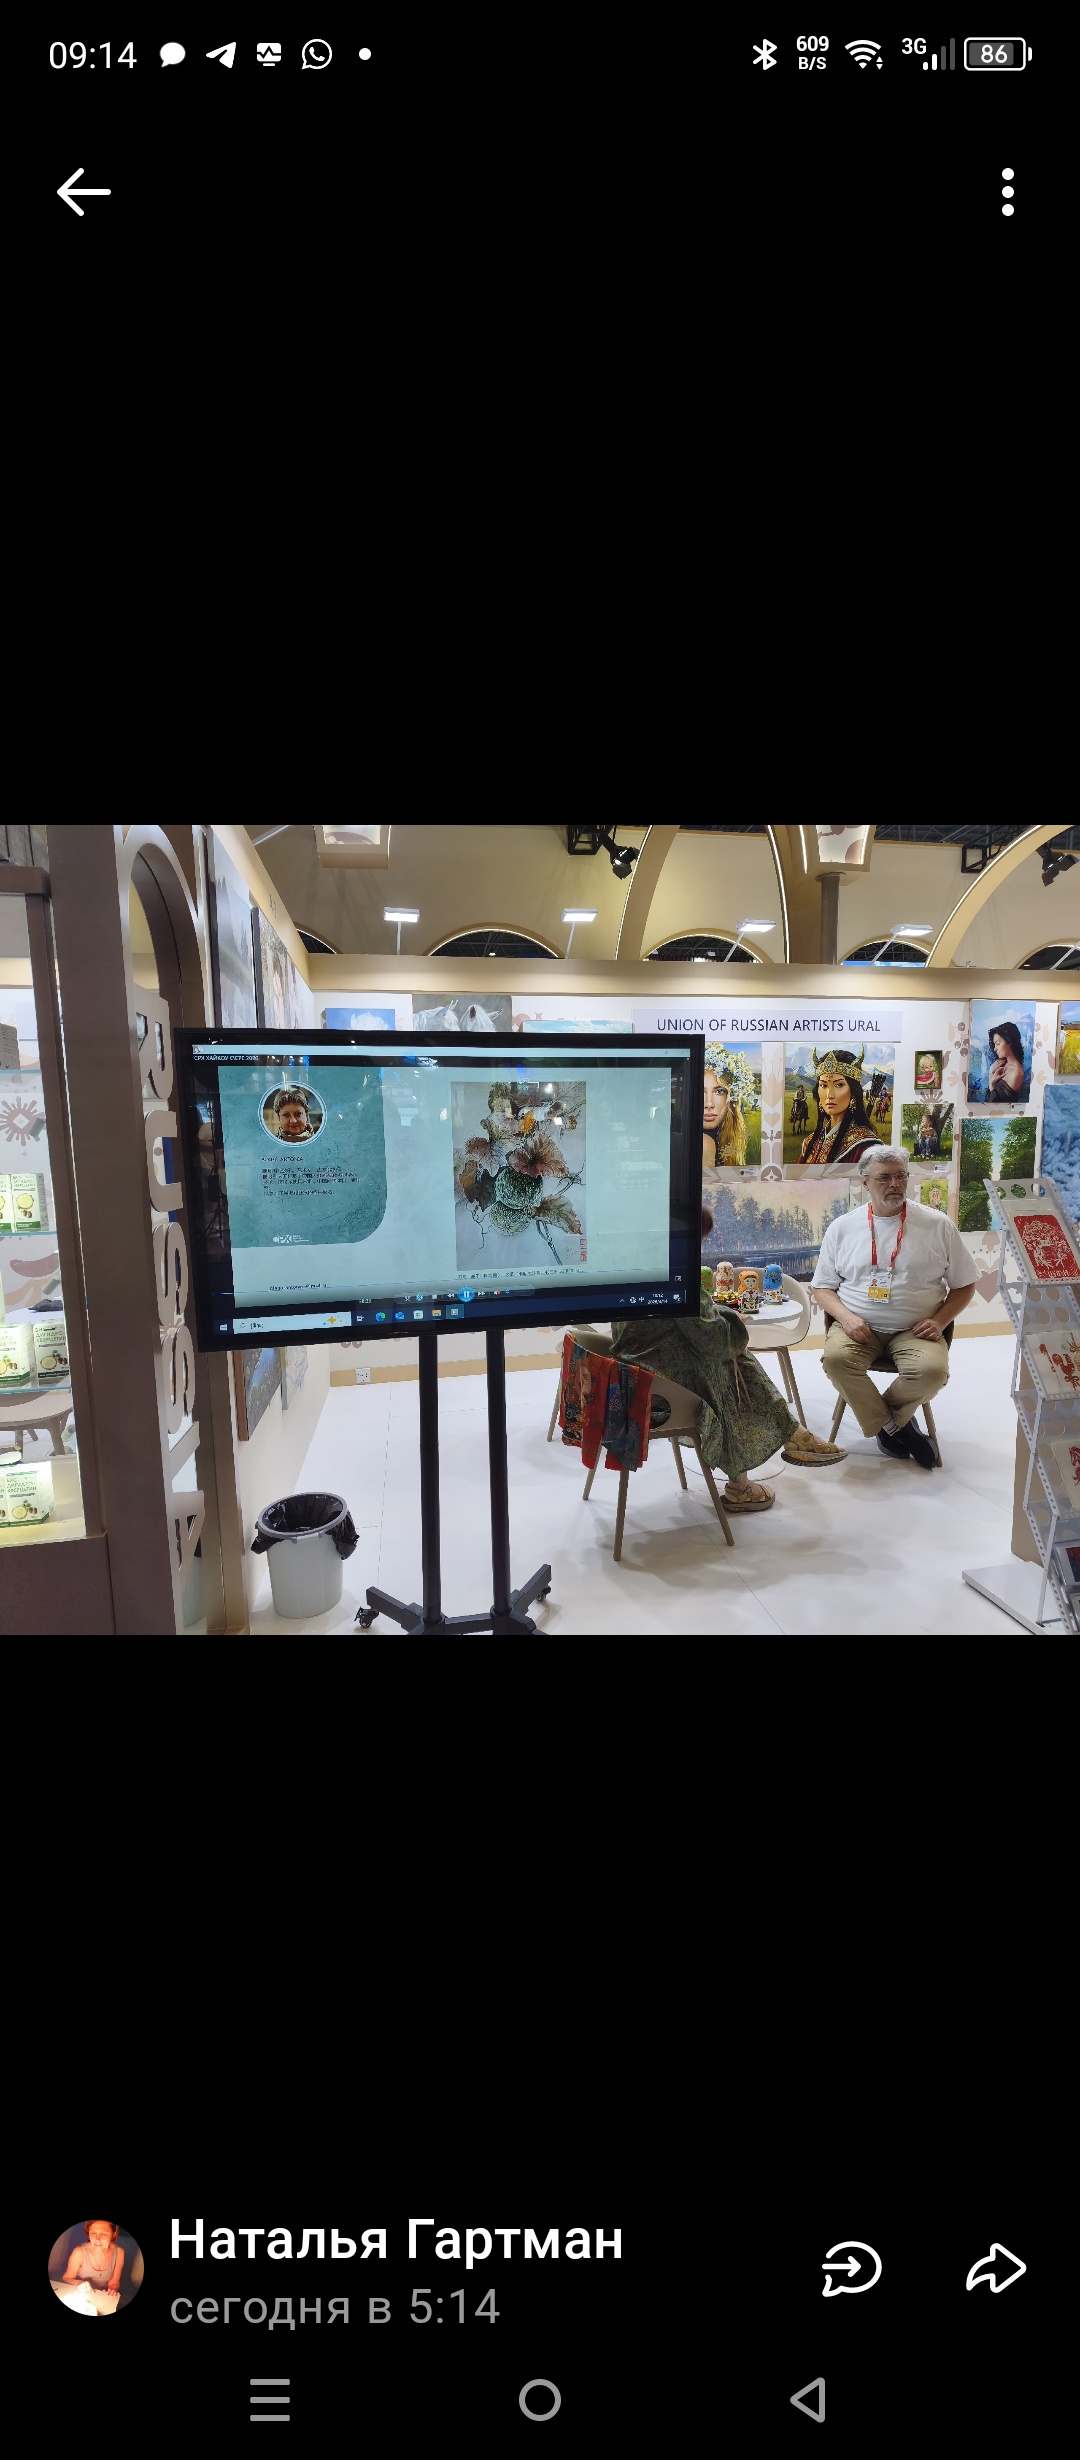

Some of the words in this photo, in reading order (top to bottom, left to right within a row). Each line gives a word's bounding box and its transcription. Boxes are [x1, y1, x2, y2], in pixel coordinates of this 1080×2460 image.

[656, 1018, 704, 1032] UNION
[708, 1019, 727, 1031] OF
[731, 1019, 789, 1032] RUSSIAN
[792, 1019, 844, 1032] ARTISTS
[848, 1020, 881, 1032] URAL
